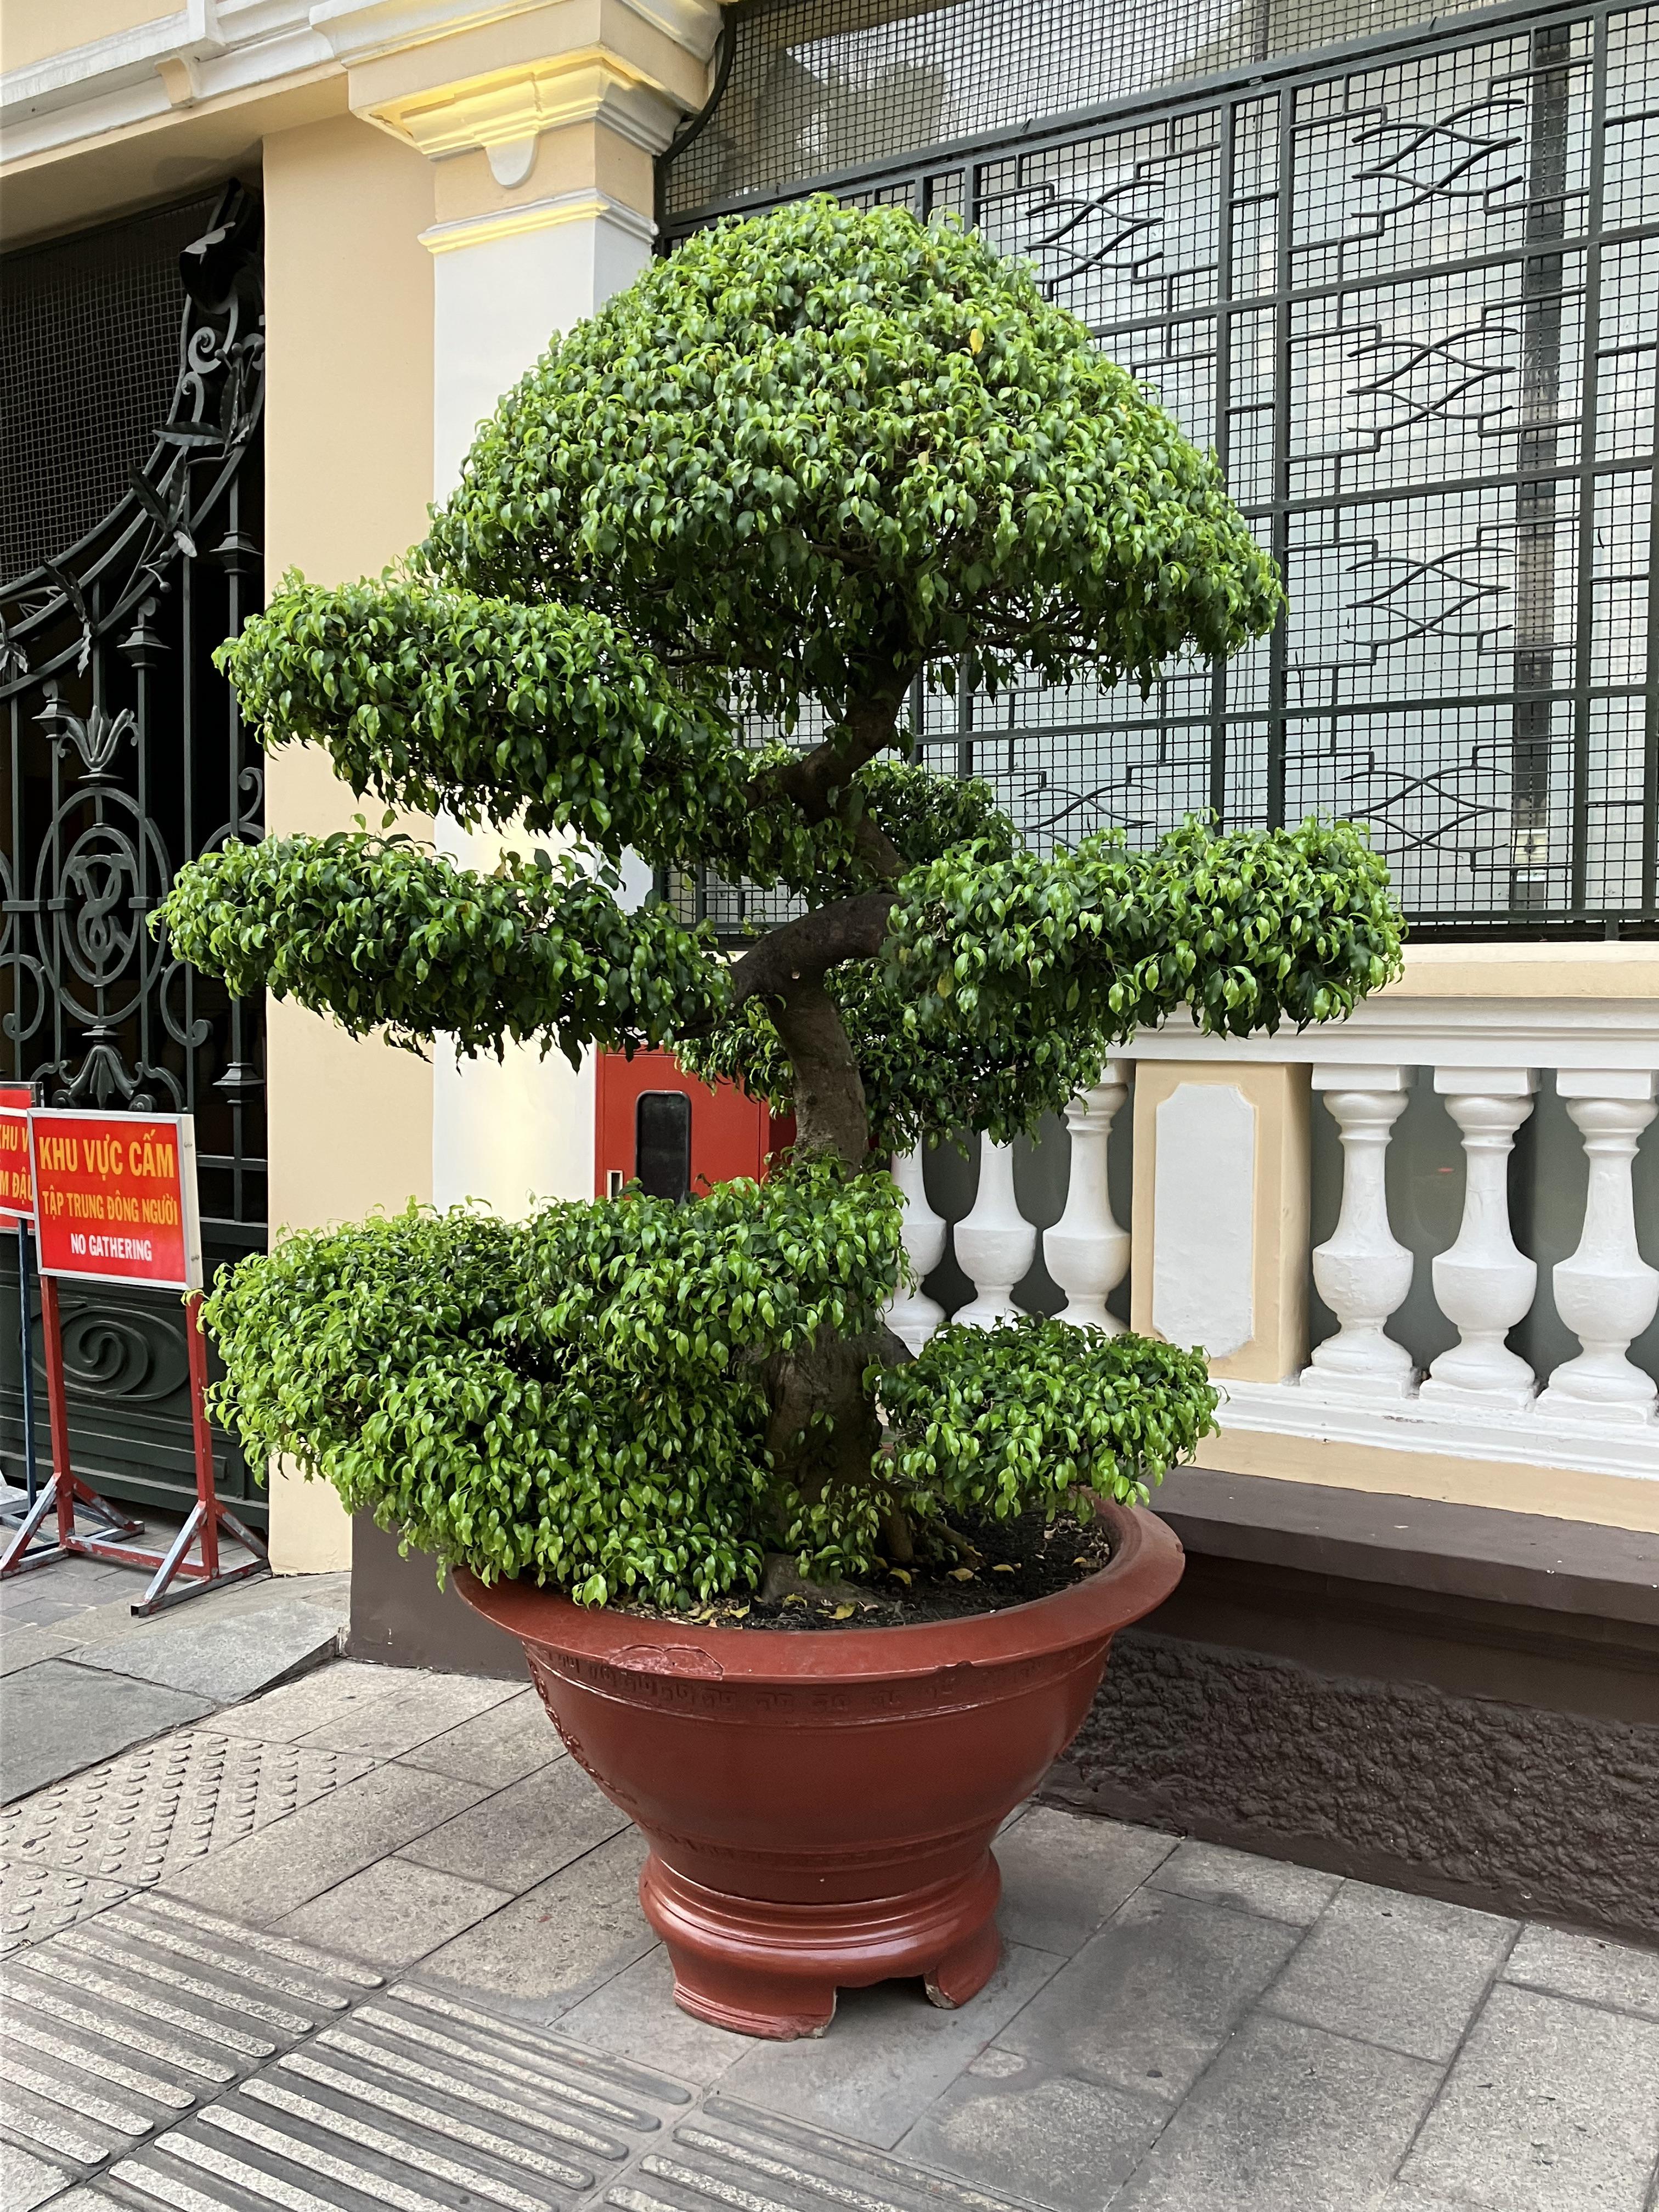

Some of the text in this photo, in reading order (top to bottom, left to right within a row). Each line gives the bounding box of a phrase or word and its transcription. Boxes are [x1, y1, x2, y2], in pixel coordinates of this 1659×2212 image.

[0, 1125, 18, 1151] HU
[39, 1128, 174, 1181] KHU VỰC CẤM
[42, 1185, 178, 1225] TẬP TRUNG ĐÔNG NGƯỜI
[70, 1233, 152, 1261] NO GATHERING
